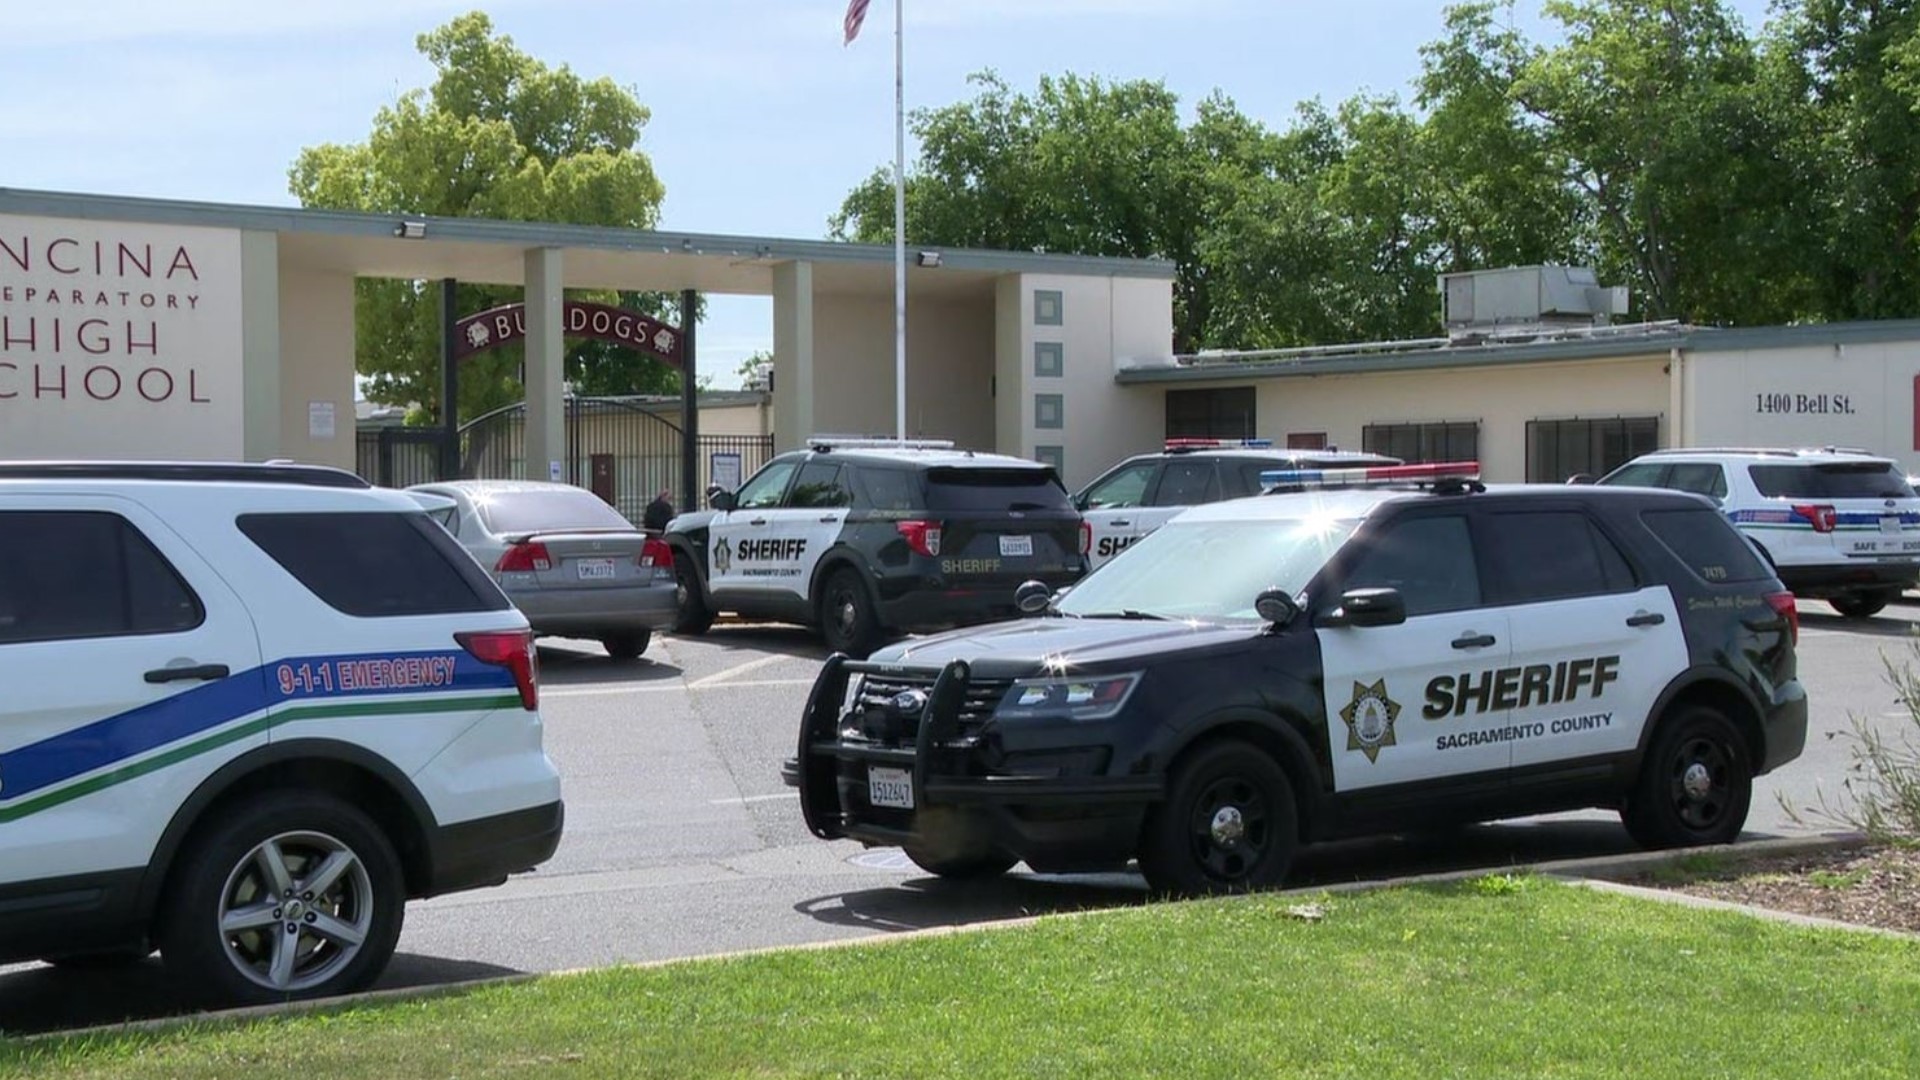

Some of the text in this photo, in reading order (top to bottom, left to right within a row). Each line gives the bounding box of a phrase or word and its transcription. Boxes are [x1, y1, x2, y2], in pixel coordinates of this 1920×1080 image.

[3, 286, 199, 309] EPARATORY
[3, 316, 157, 355] HIGH
[495, 308, 648, 344] BUDOGS
[0, 362, 211, 403] CHOOL
[1756, 393, 1855, 414] 1400 Bell St.
[738, 538, 807, 561] SHERIFF
[1853, 542, 1877, 550] SAFE
[941, 559, 1000, 574] SHERIFF
[278, 657, 456, 694] 9-1-1 EMERGENCY
[1422, 655, 1620, 720] SHERIFF
[1436, 713, 1613, 750] SACRAMENTO COUNTY
